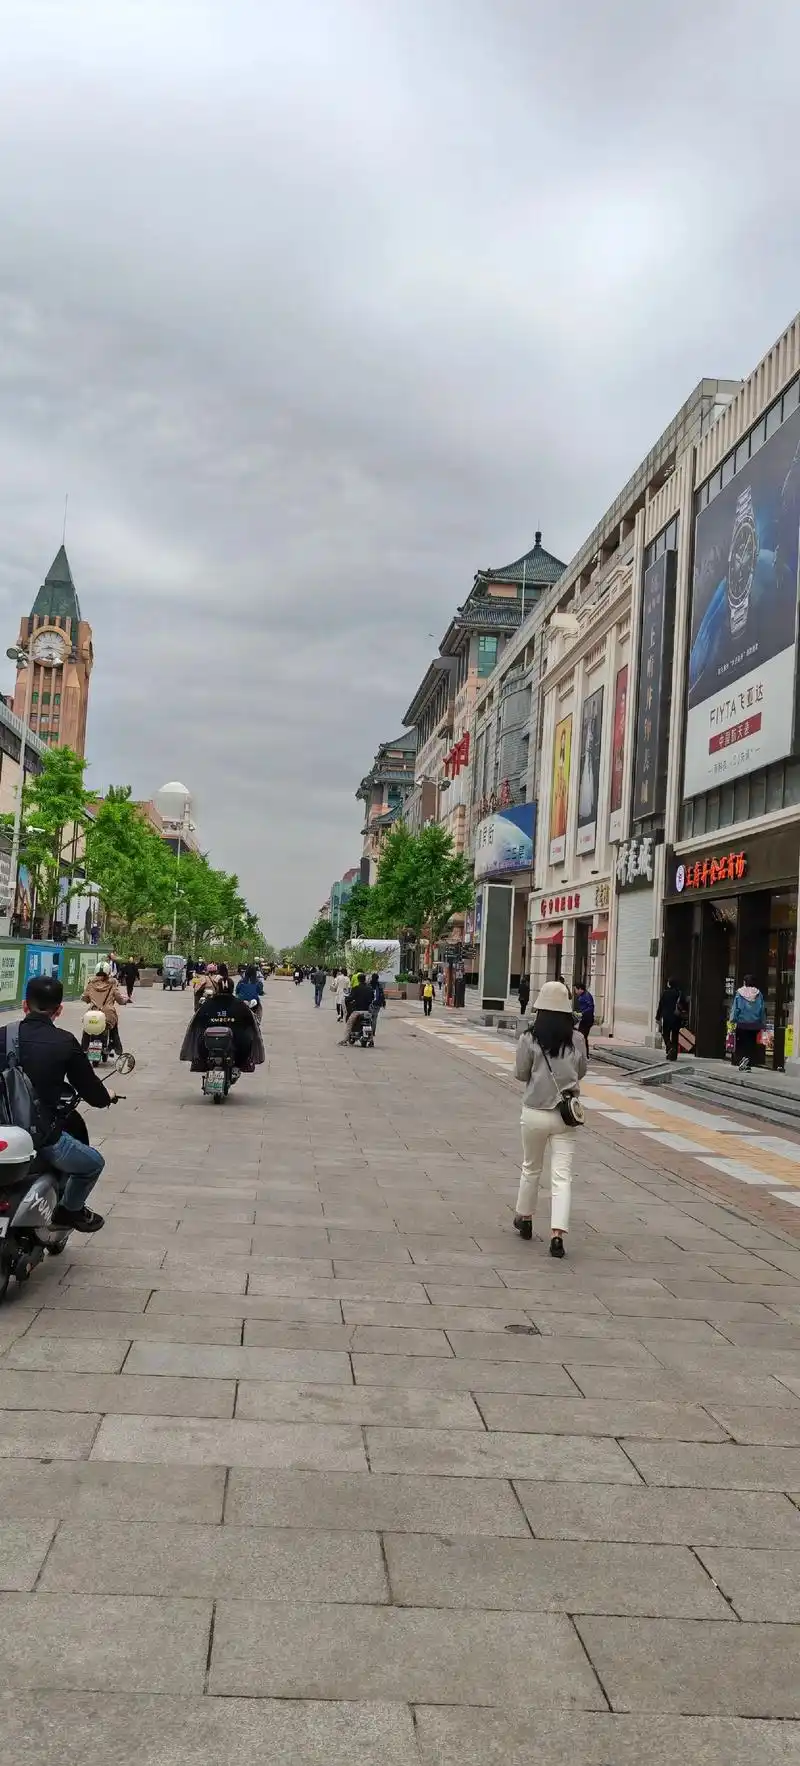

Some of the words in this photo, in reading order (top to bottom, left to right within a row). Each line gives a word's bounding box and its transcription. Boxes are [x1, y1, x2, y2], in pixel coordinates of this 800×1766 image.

[709, 699, 736, 728] FIYTA
[738, 682, 764, 710] 飞亚达
